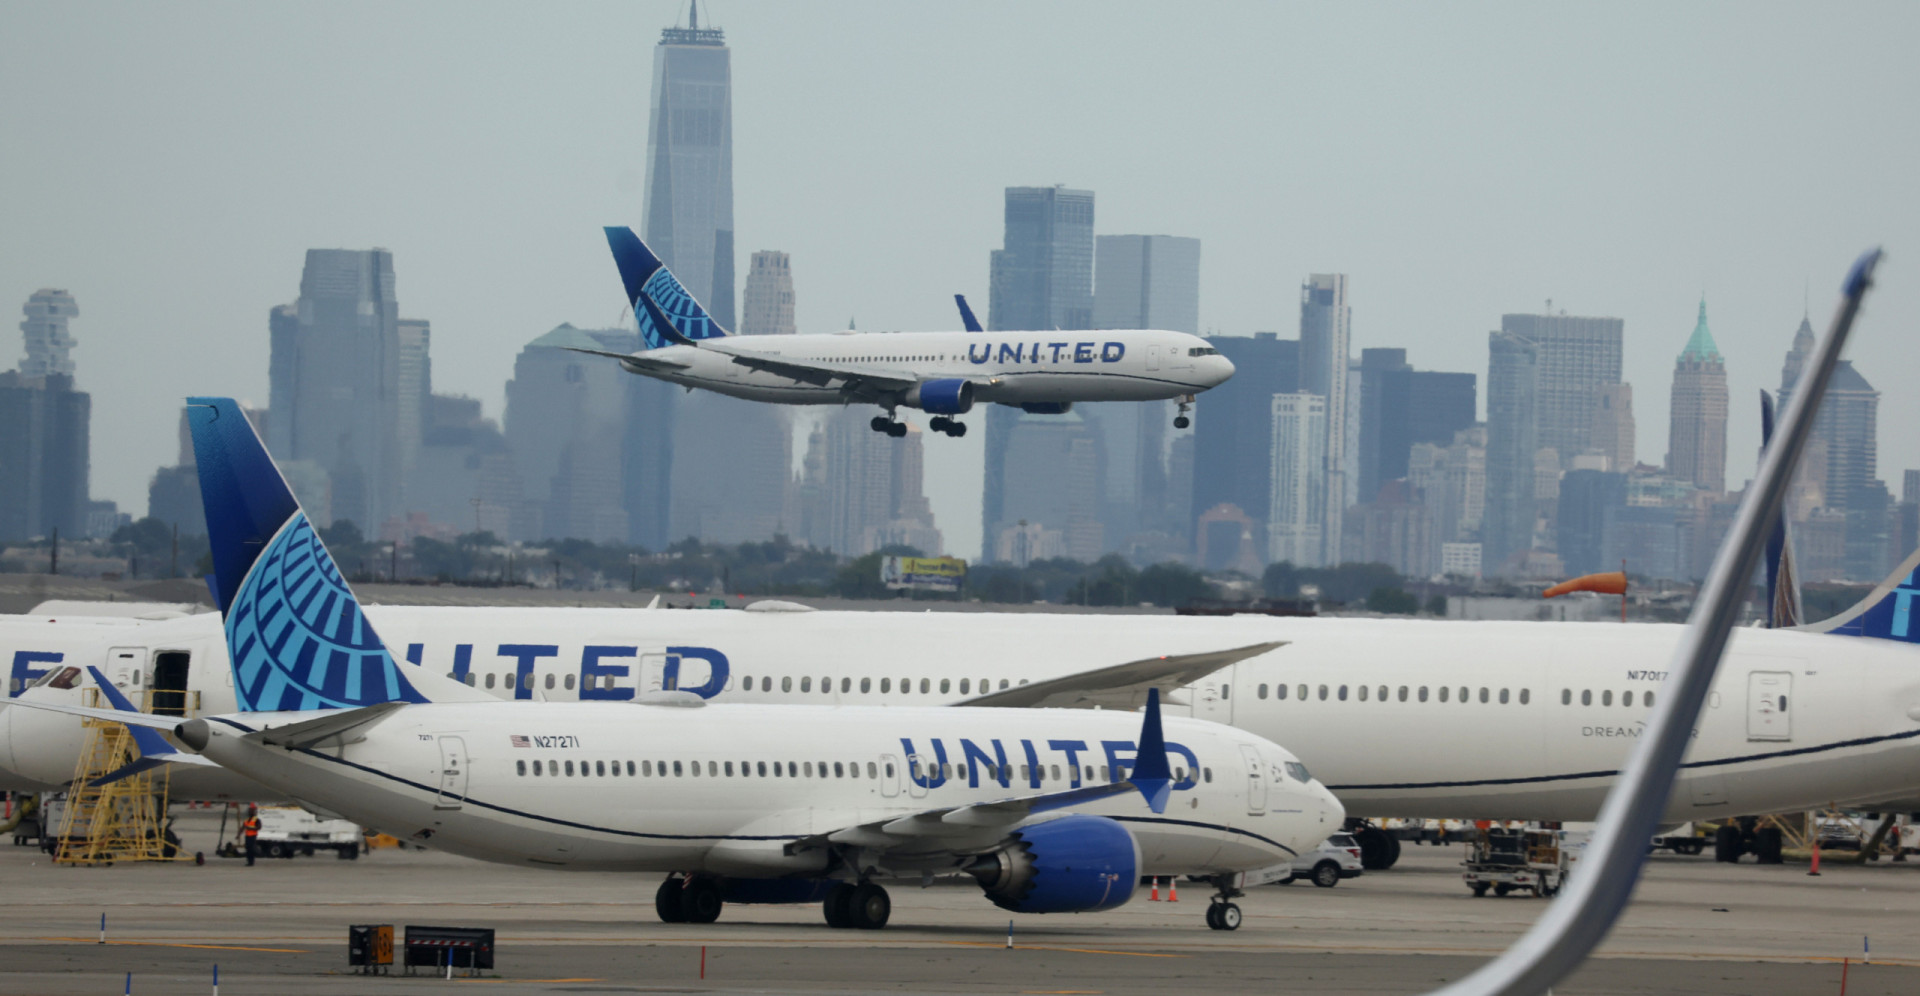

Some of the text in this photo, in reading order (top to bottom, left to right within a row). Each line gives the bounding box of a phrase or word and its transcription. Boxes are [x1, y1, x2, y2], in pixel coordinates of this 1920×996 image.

[968, 342, 1126, 365] UNITED
[406, 643, 730, 701] ITED
[533, 736, 580, 748] N27271
